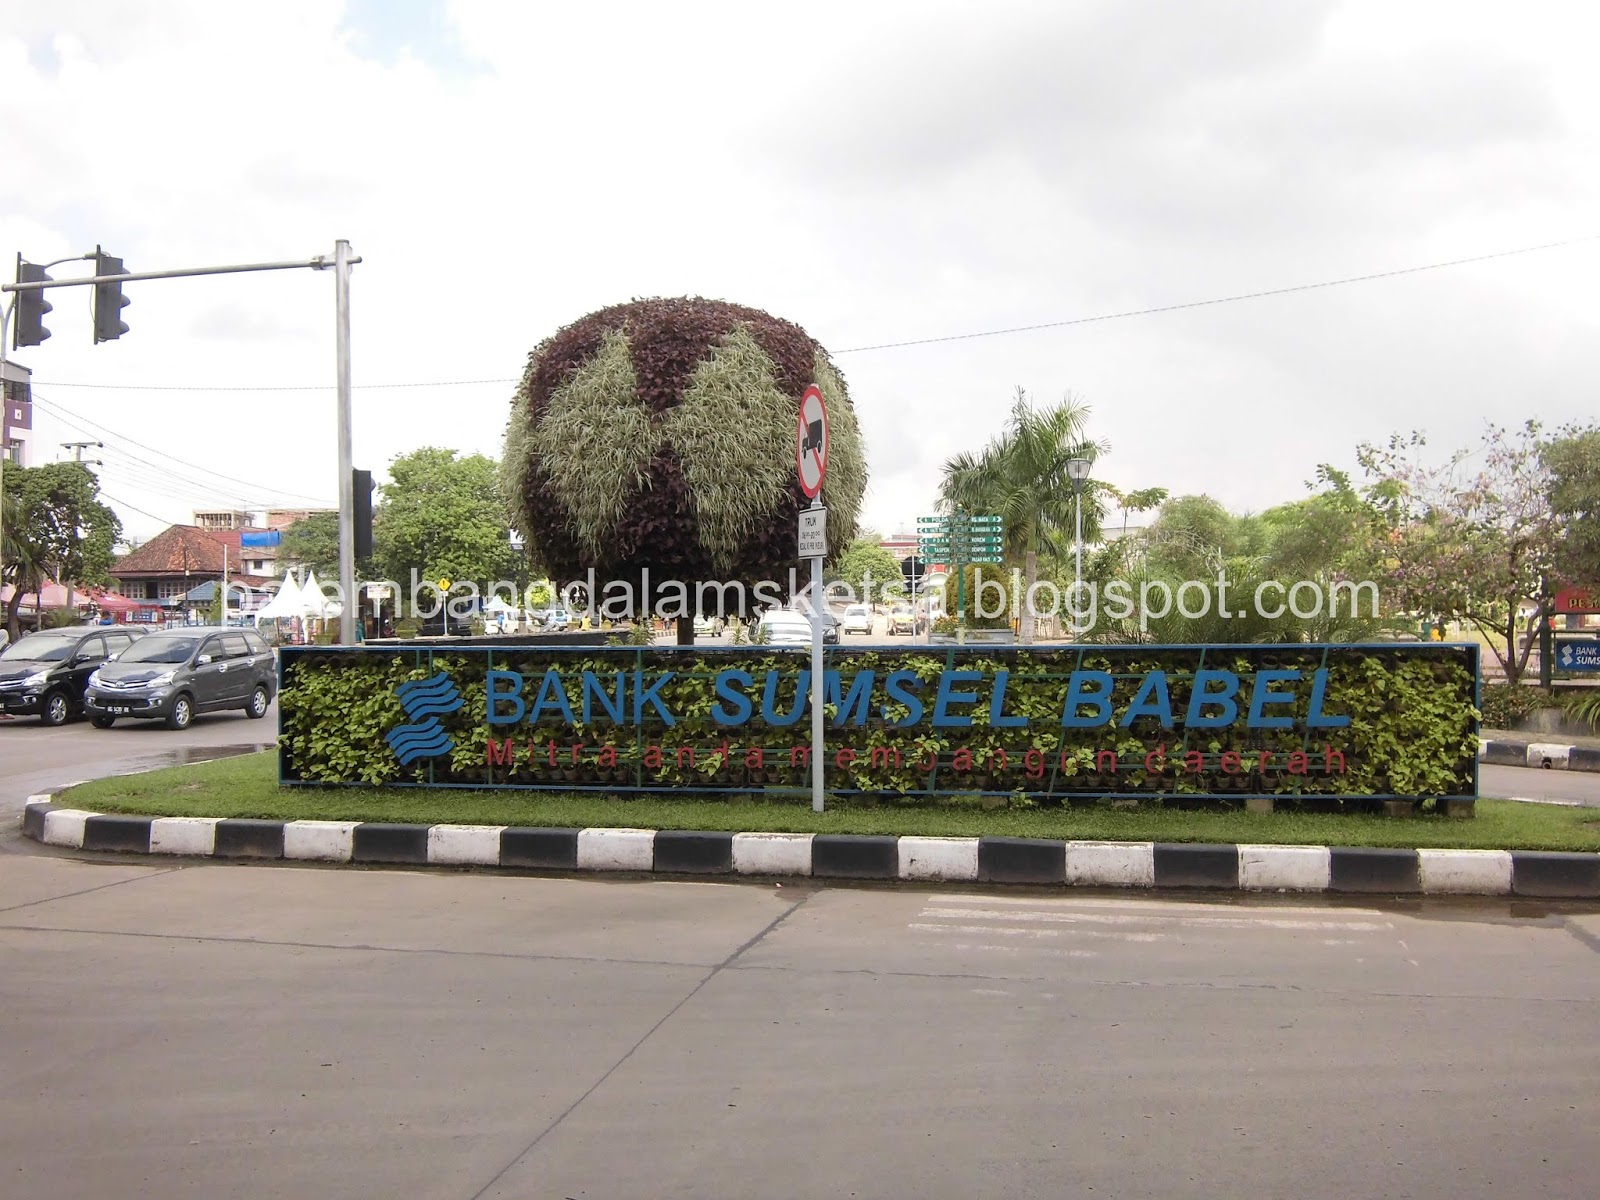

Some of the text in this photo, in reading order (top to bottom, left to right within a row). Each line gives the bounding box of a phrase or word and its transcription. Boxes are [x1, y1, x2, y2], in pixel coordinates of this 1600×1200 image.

[1576, 647, 1597, 655] BANK
[486, 668, 1350, 729] BANK SUMSEL BABEL
[486, 737, 618, 768] Mitra
[791, 741, 1117, 780] memangn
[1145, 743, 1346, 776] daerah
